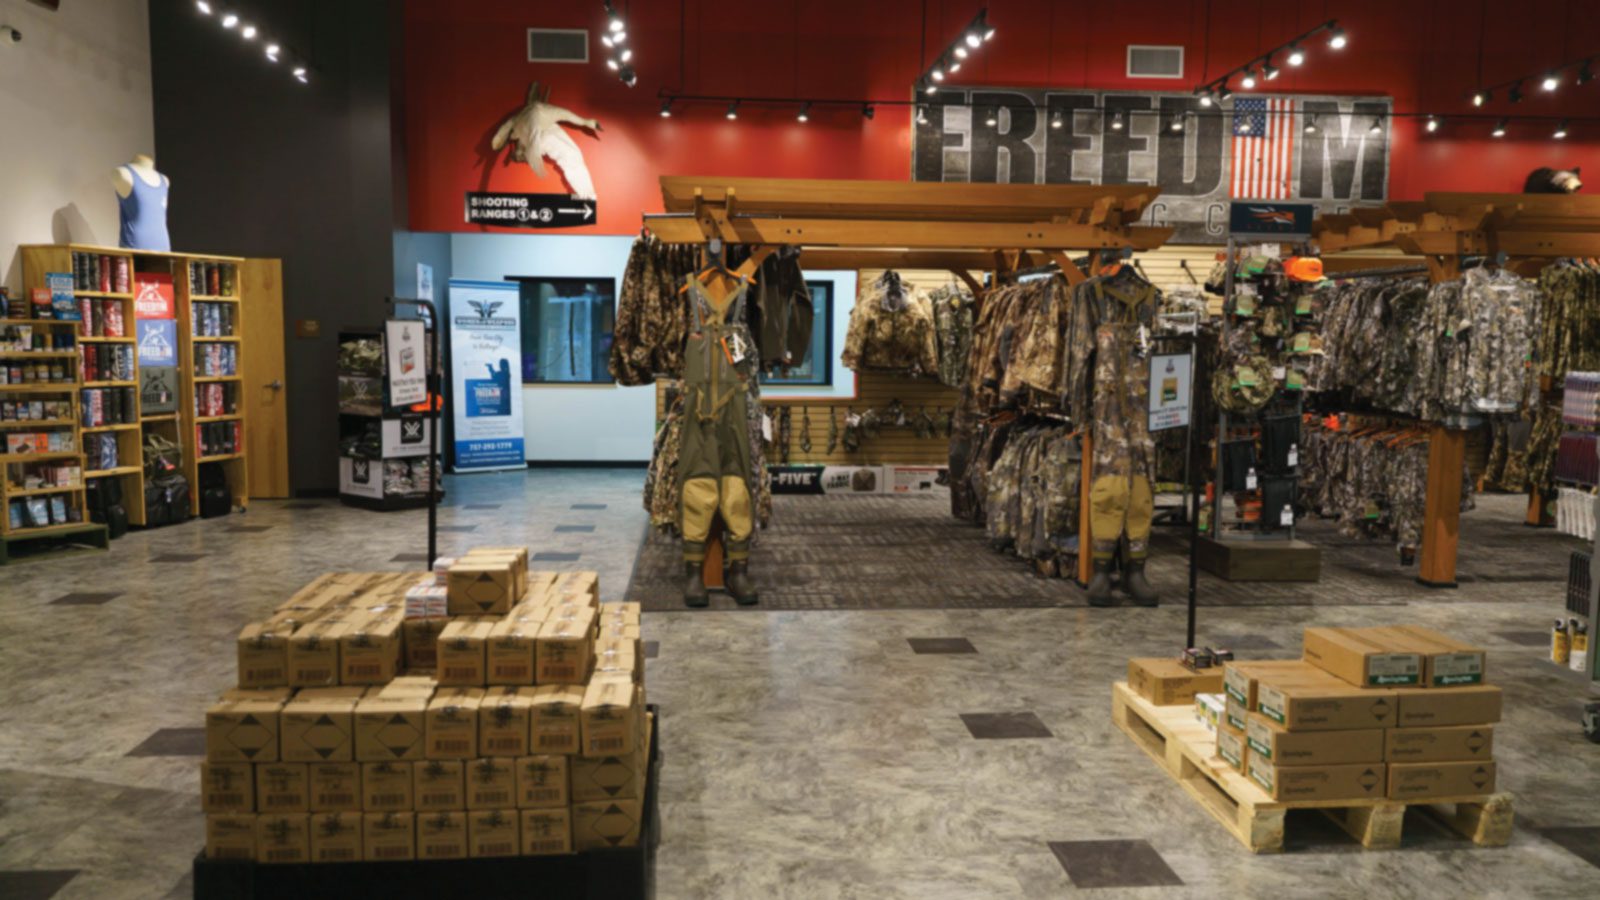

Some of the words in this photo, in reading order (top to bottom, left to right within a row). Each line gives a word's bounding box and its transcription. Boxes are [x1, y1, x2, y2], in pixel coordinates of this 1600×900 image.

[914, 91, 1389, 199] FREEDM
[471, 197, 529, 208] SHOOTING
[471, 209, 516, 219] RANGES
